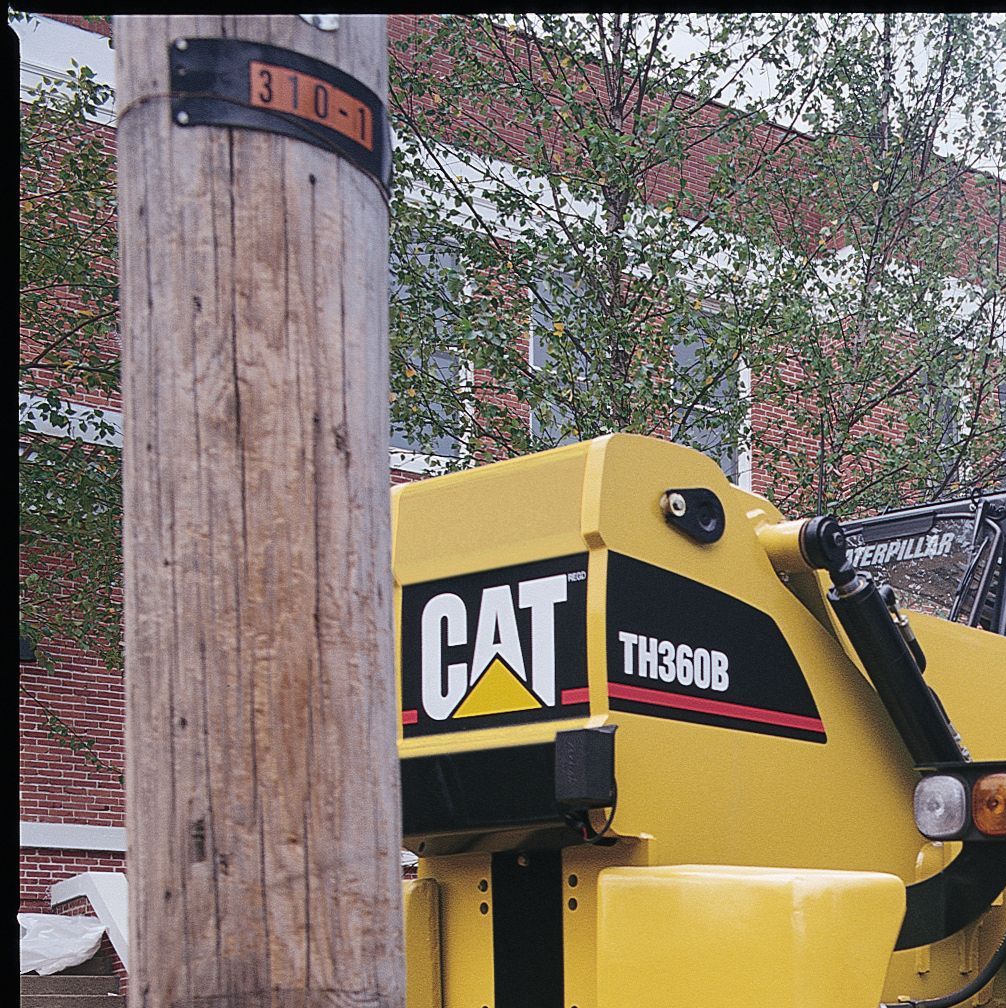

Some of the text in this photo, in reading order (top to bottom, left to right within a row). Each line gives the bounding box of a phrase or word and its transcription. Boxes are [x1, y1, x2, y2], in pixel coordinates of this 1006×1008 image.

[259, 69, 366, 148] 310-1
[845, 532, 955, 568] ATERPILLAR
[421, 574, 568, 721] CAT
[618, 630, 730, 692] TH360B
